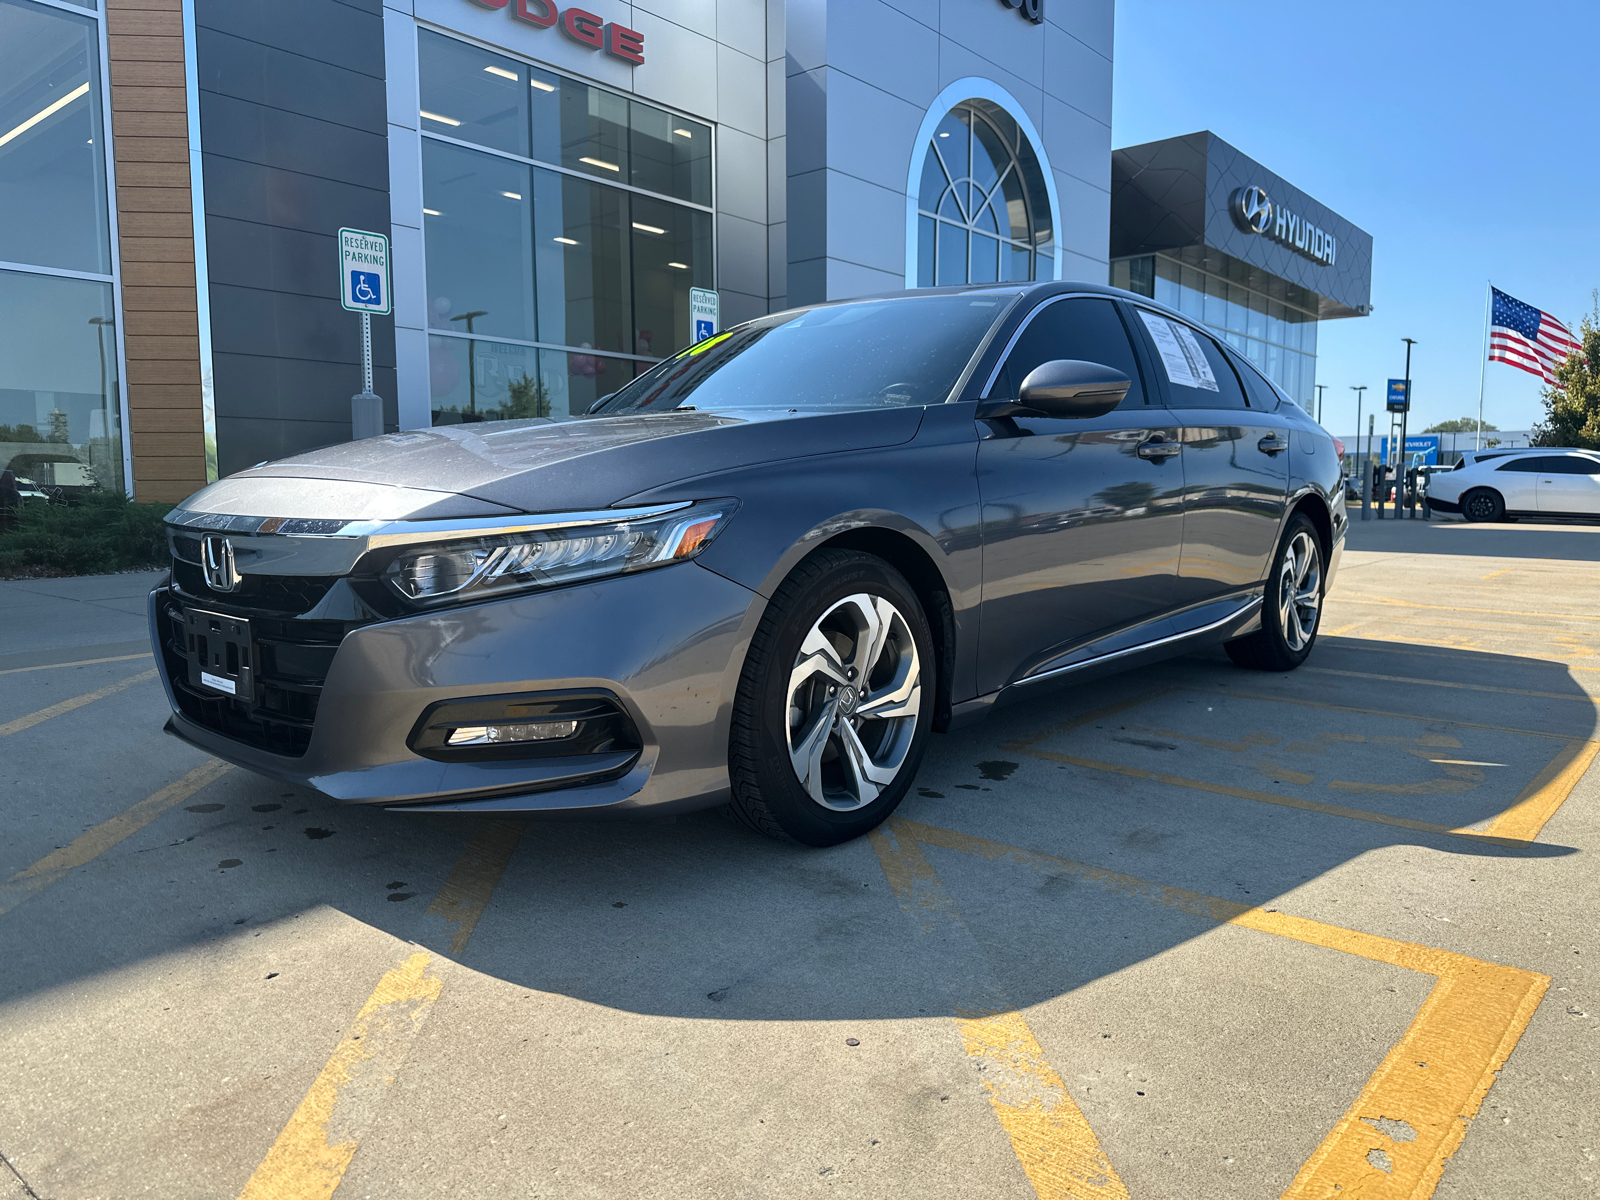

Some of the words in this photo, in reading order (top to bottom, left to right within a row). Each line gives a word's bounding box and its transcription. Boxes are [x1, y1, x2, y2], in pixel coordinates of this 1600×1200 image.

[1274, 204, 1336, 266] HYUNDAI
[344, 236, 384, 253] RESERVED
[344, 250, 385, 267] PARKING
[693, 293, 716, 306] RESERVED
[693, 304, 717, 316] PARKING
